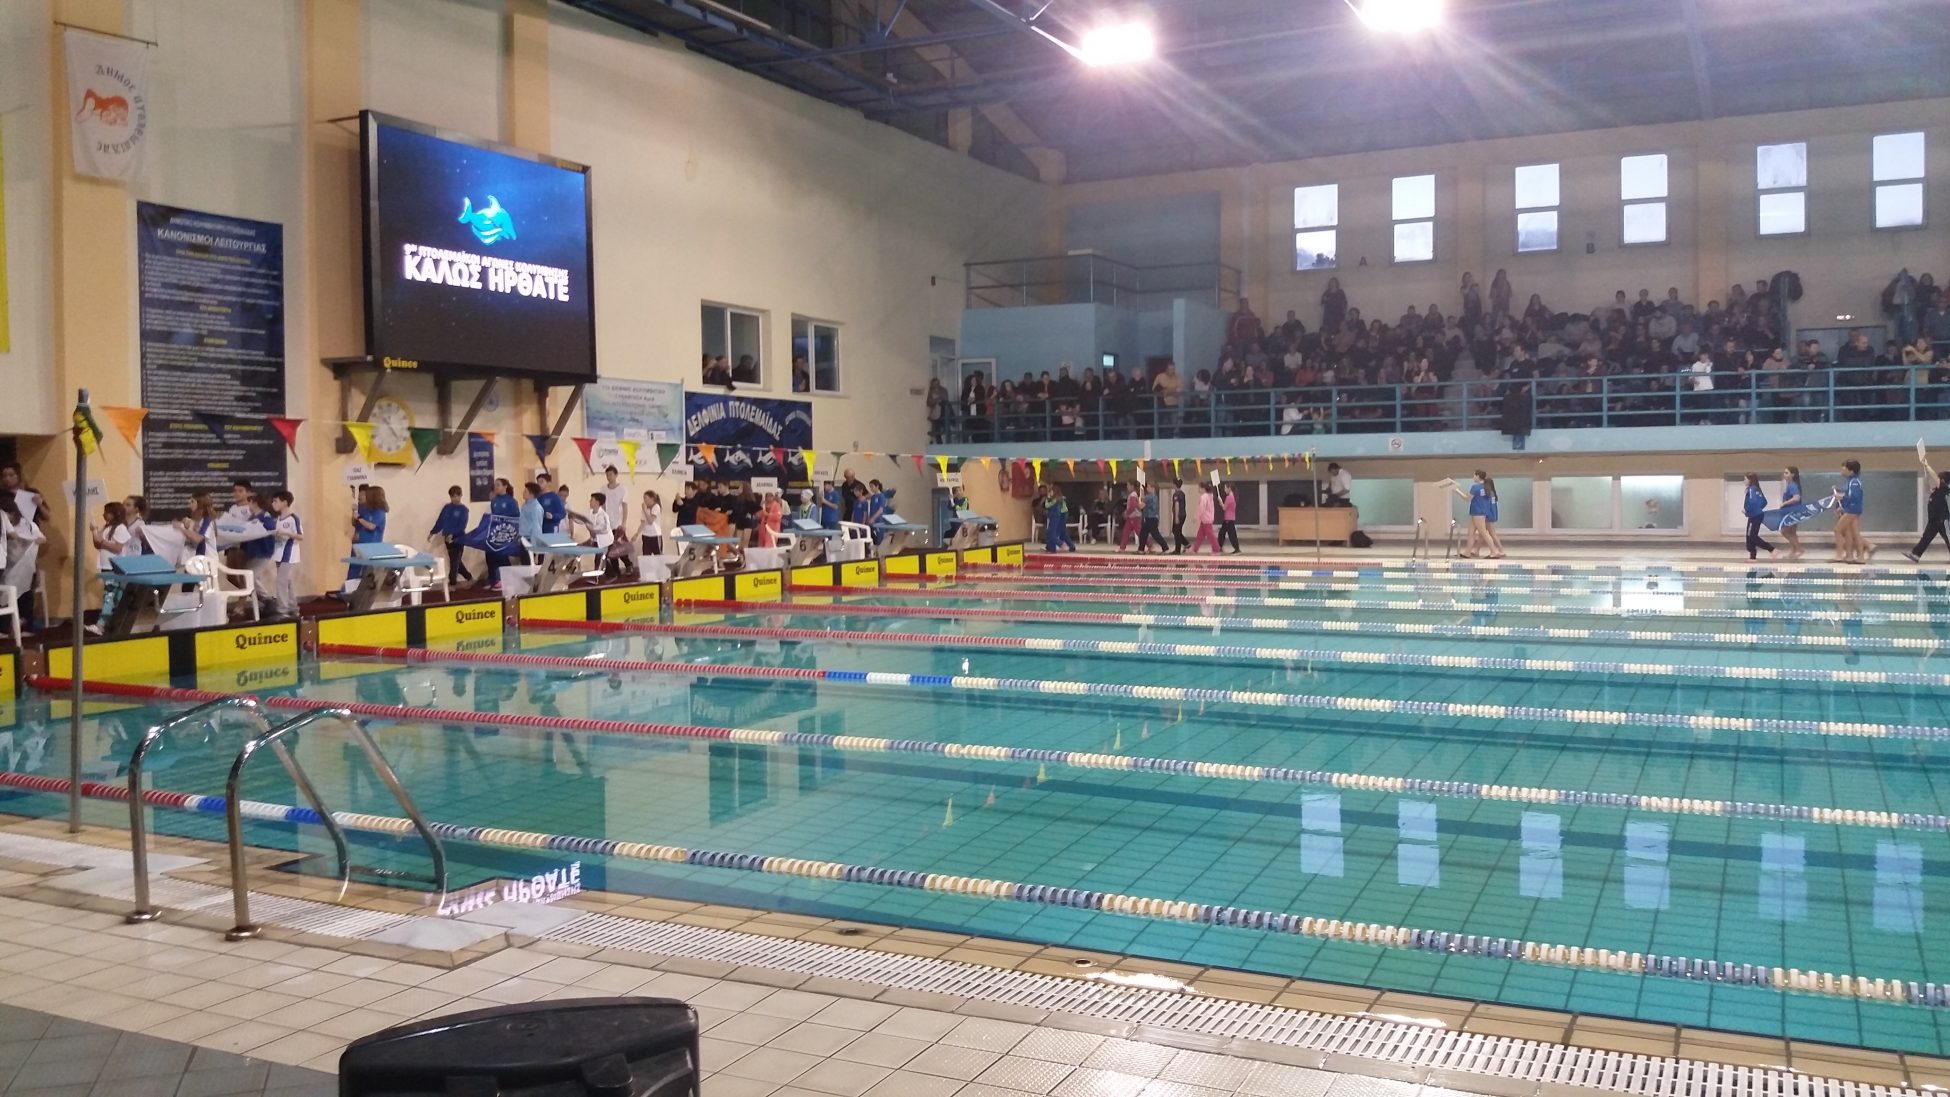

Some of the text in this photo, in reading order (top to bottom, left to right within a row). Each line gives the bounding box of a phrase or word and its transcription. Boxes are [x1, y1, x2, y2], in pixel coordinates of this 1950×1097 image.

[404, 254, 570, 302] ΚΑΛΩΣ ΗΡΘΑΤΕ
[687, 402, 726, 437] ΔΕΛΦΙΝΙΑ
[548, 560, 556, 574] 4
[367, 573, 376, 590] 3
[753, 577, 777, 587] Quince
[623, 591, 654, 603] Quince
[456, 609, 496, 623] Quince
[235, 632, 289, 649] Quince
